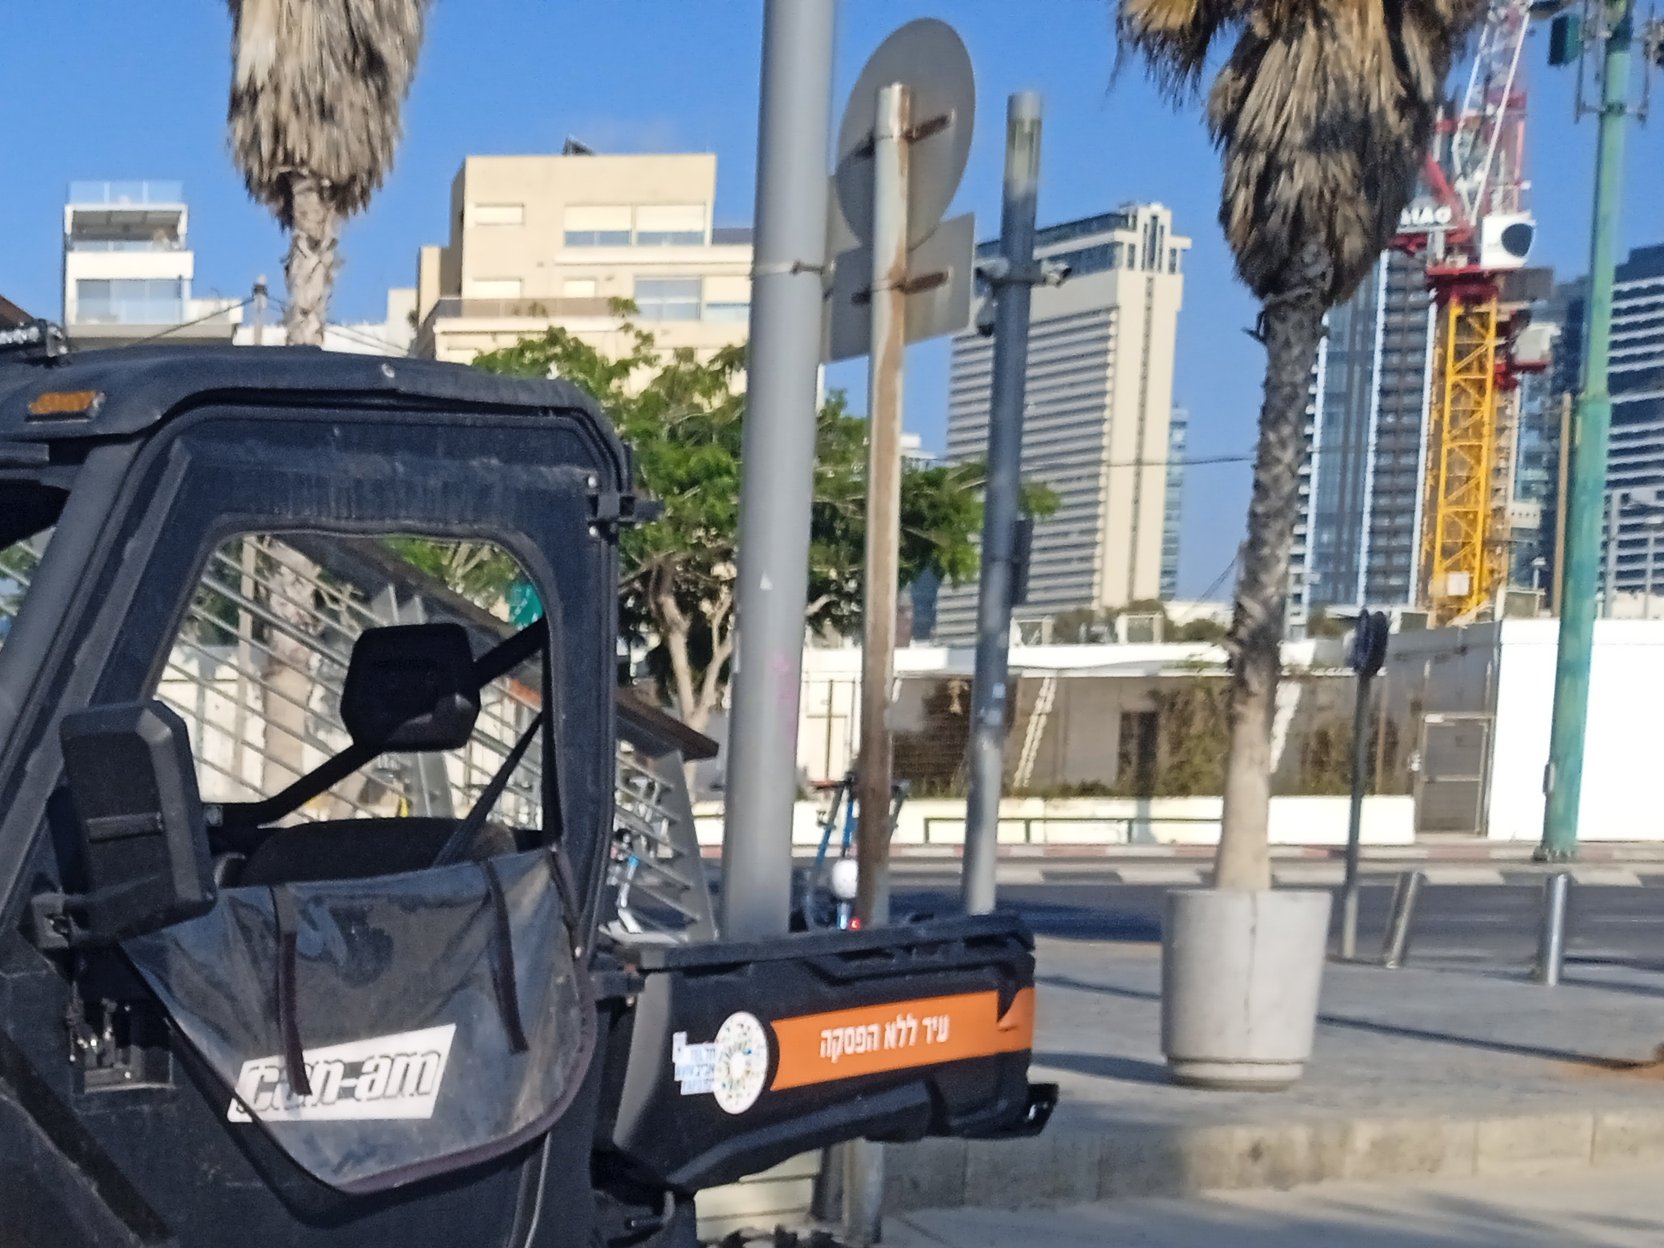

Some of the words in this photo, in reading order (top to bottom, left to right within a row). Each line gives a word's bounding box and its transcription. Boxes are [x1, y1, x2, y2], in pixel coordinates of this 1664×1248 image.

[819, 1022, 881, 1064] הפסקה
[883, 1012, 919, 1050] ללא
[921, 1014, 950, 1044] עיר
